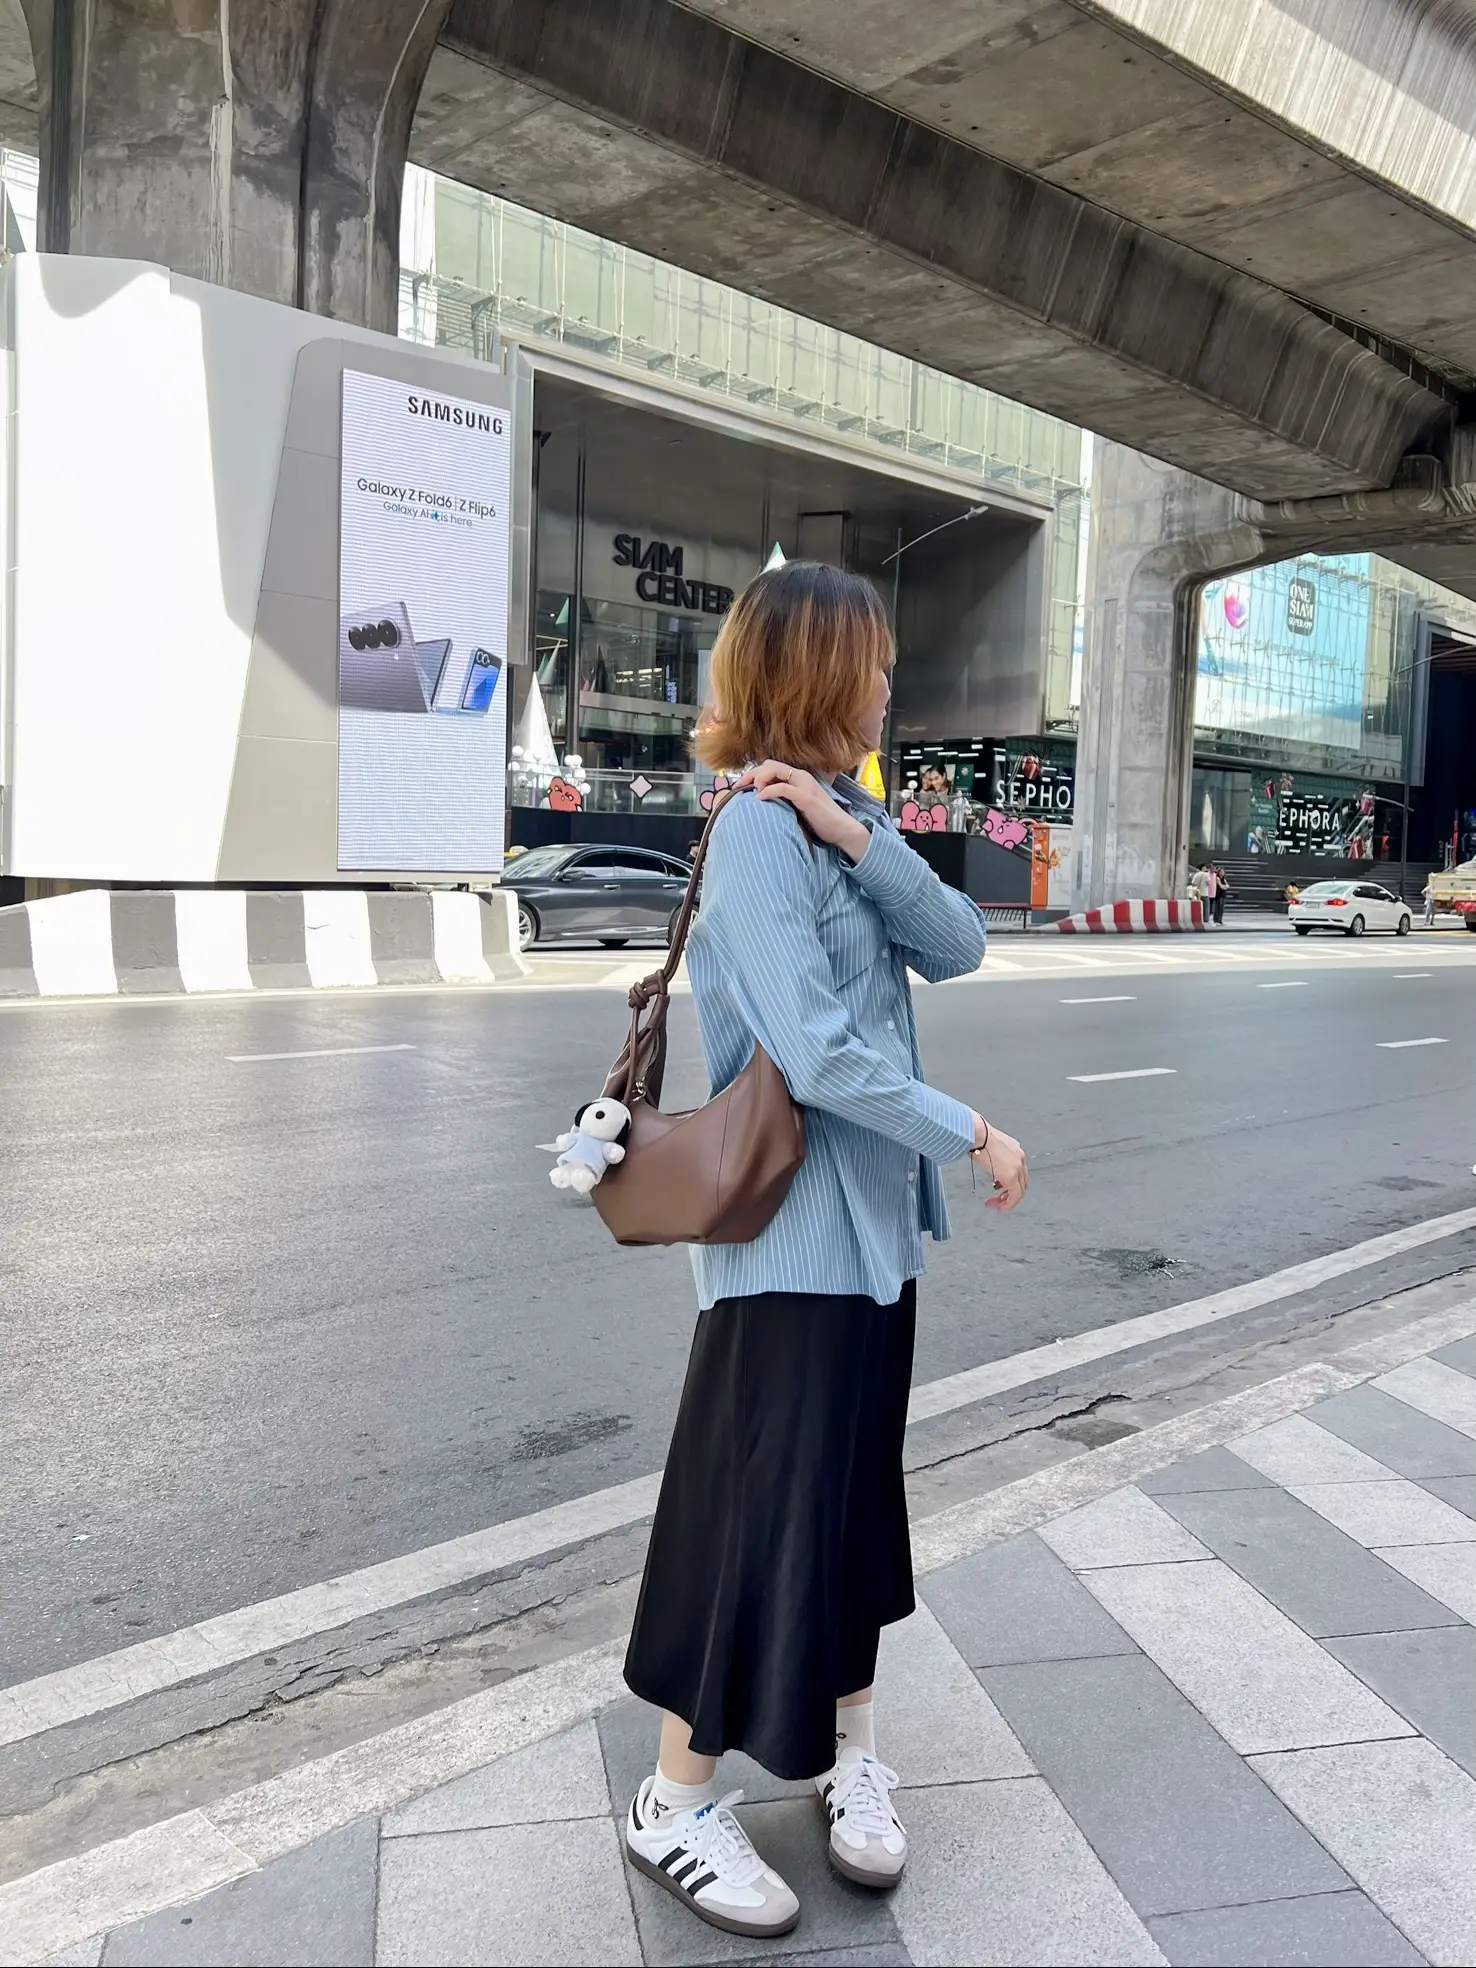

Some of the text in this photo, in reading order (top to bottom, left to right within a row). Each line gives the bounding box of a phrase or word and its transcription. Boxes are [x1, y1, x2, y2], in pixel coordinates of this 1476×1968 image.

[408, 396, 503, 435] SAMSUNG
[357, 478, 496, 519] Galaxy Z Fold6 Z Flip6
[383, 501, 473, 527] Galaxy AI is here
[612, 533, 684, 576] SIAM
[635, 571, 734, 614] CENTER
[1289, 584, 1312, 603] ONE
[1289, 600, 1314, 619] SIAM
